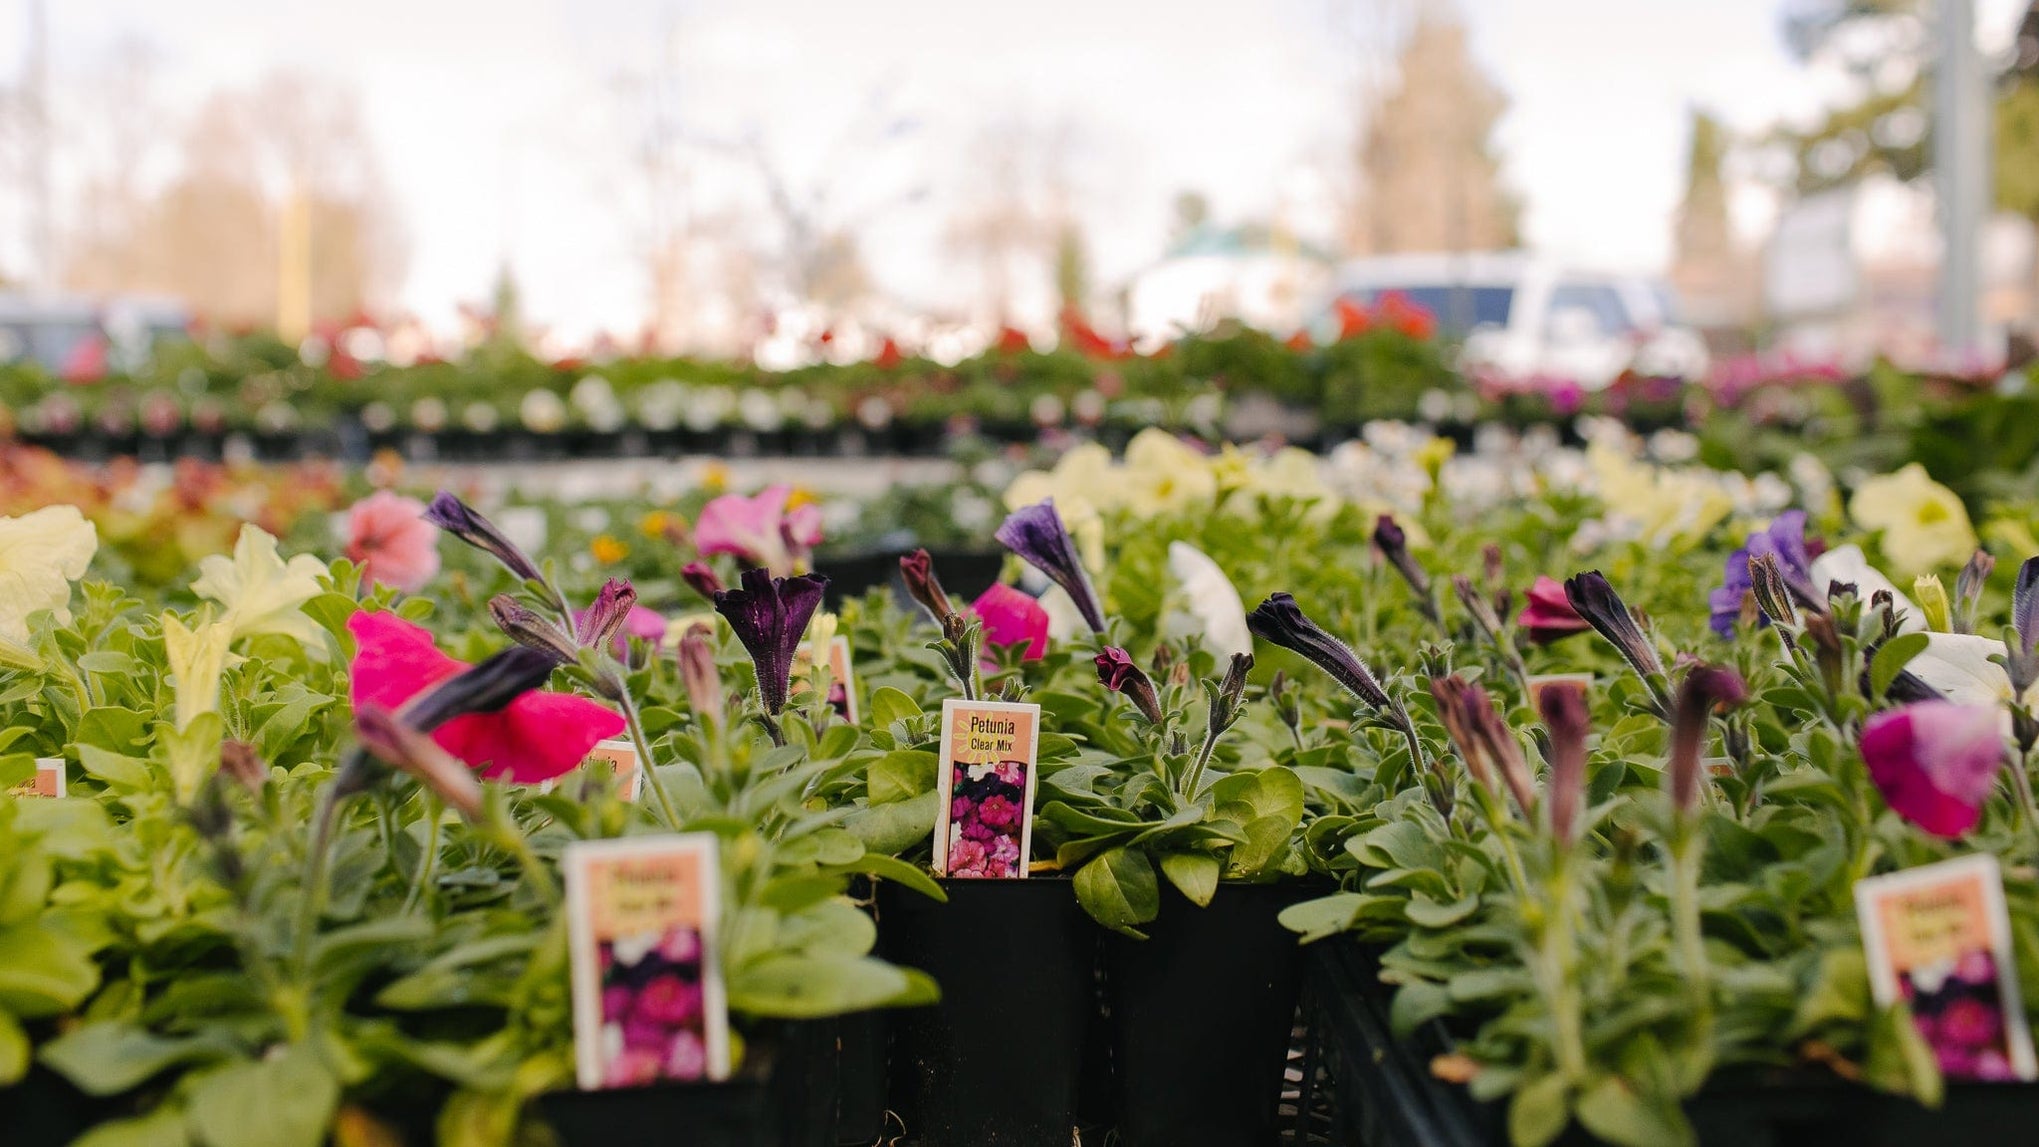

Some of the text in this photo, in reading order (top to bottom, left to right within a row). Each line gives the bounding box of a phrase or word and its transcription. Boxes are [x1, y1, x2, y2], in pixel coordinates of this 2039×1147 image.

[971, 716, 1015, 734] Petunia
[971, 738, 1013, 752] Clear Mix
